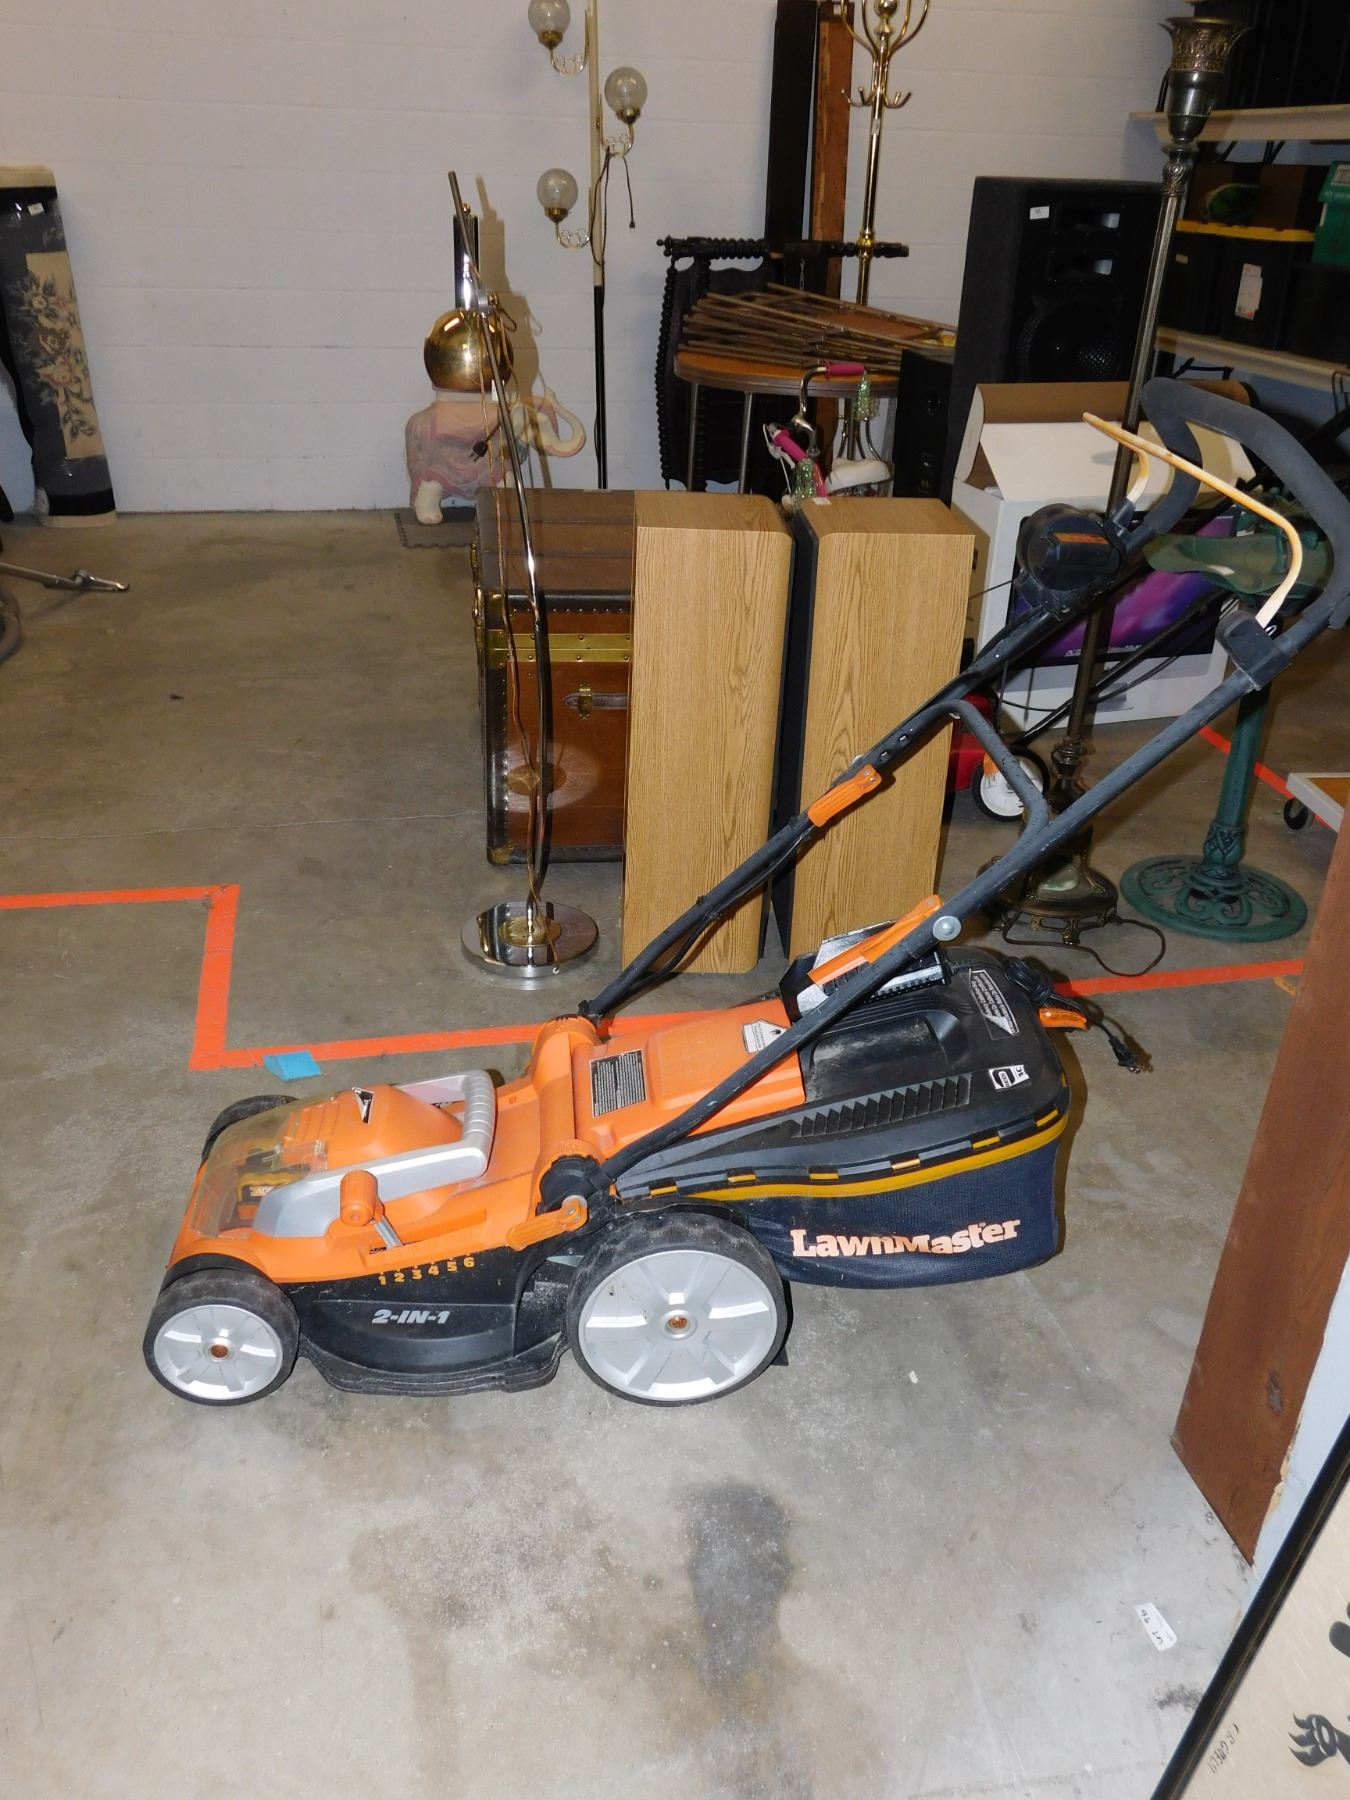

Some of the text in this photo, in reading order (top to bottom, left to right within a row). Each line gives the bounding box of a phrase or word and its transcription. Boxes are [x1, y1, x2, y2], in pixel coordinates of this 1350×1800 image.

[789, 1219, 1021, 1258] LawnMaster
[378, 1256, 475, 1286] 1 2 3 4 5 6
[371, 1309, 451, 1325] 2-IN-1
